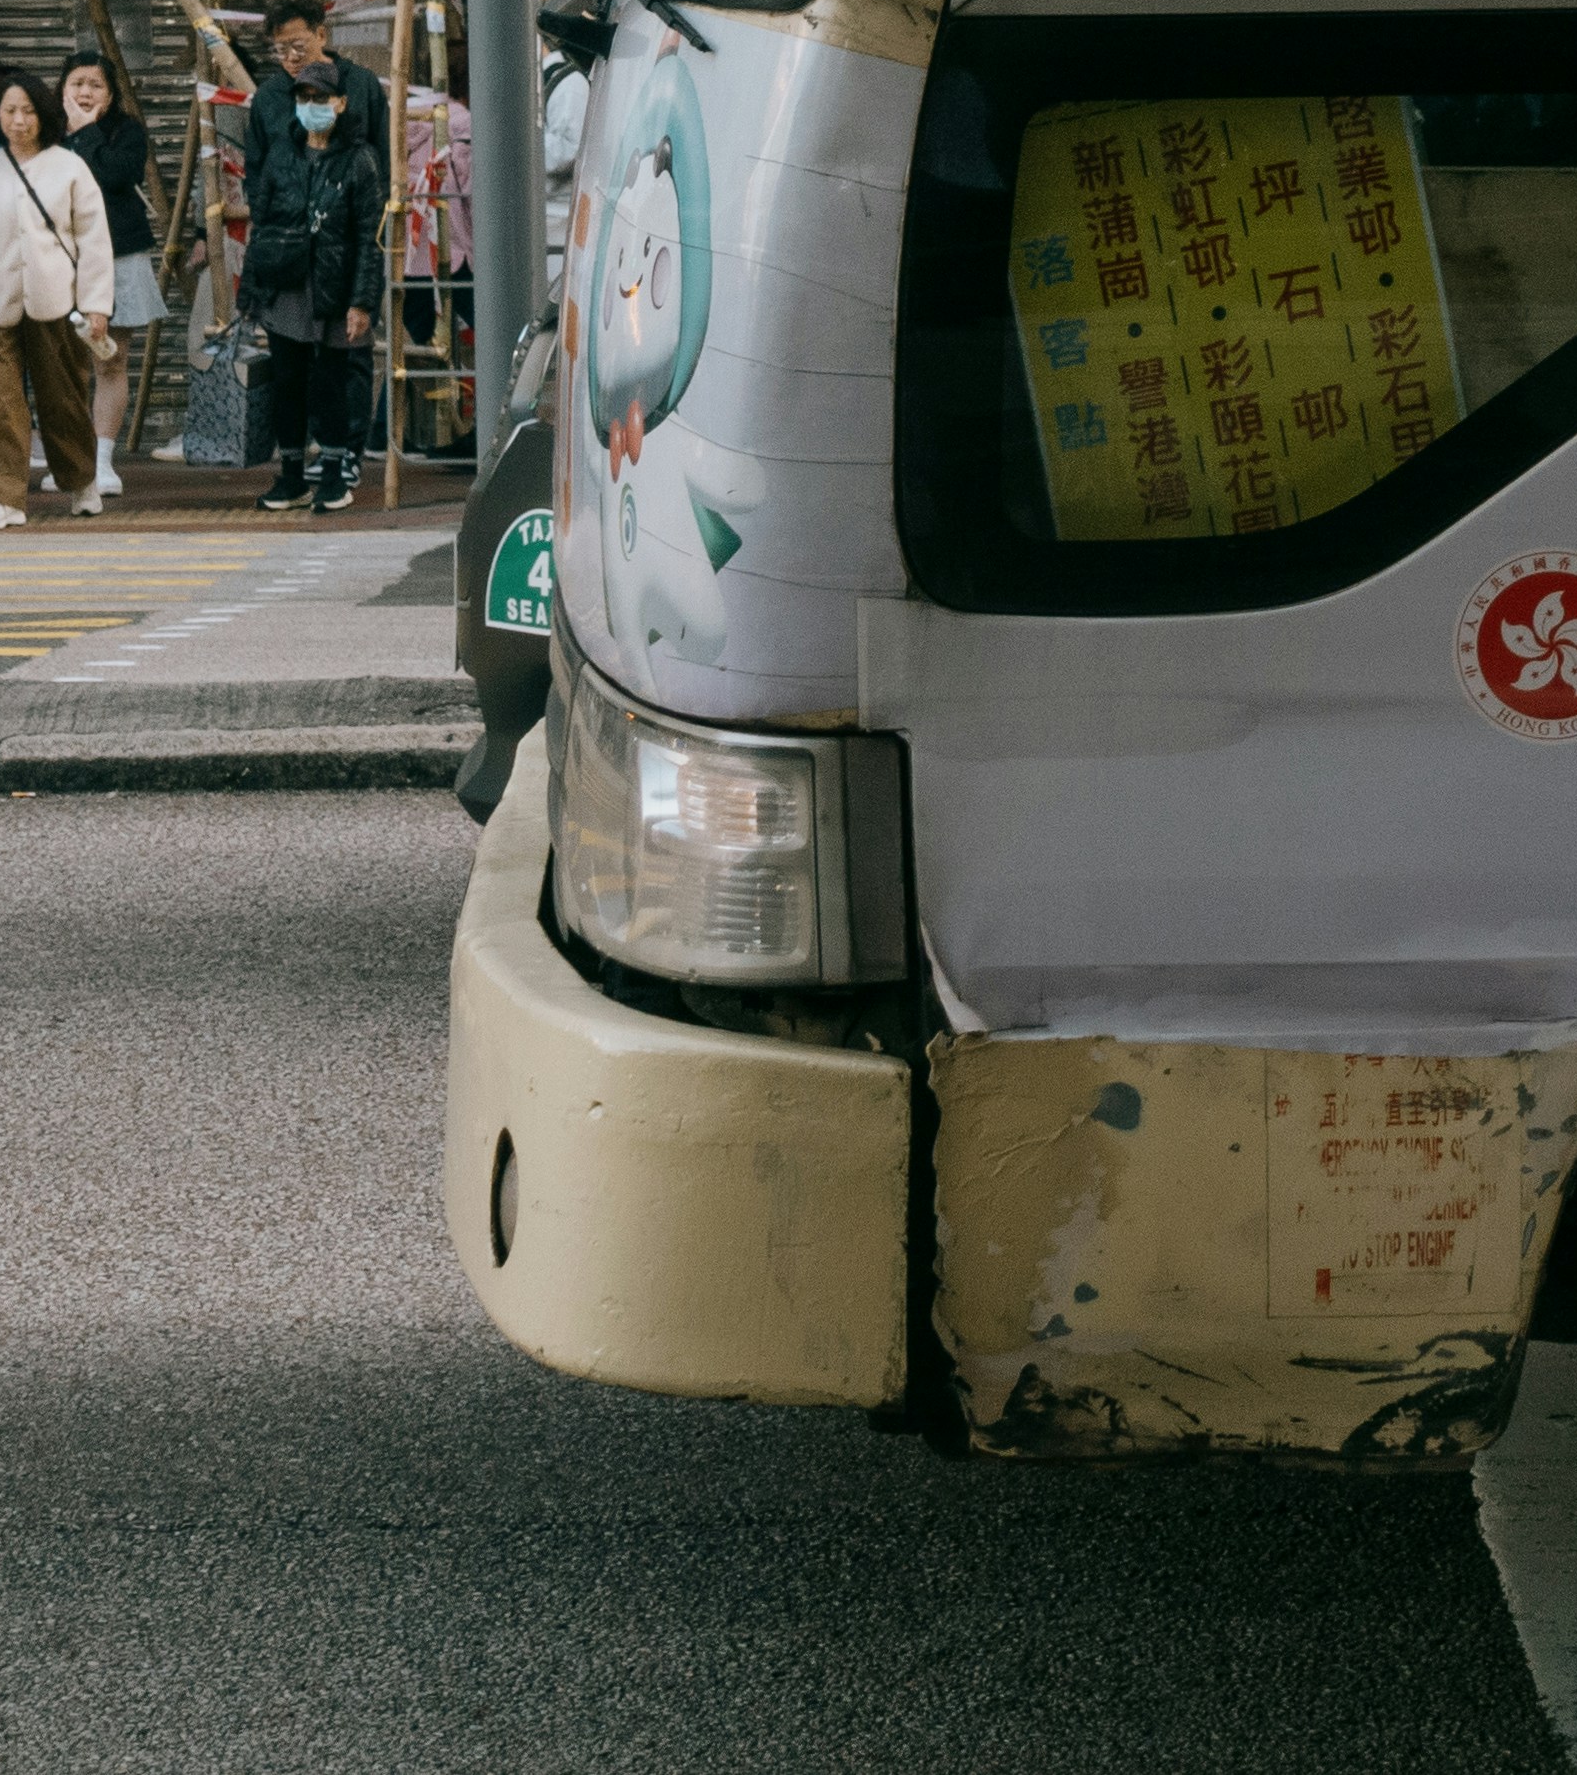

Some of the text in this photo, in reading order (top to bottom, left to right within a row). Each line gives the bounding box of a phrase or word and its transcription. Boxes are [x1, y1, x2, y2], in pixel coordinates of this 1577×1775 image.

[1022, 235, 1107, 452] 落客點
[527, 550, 553, 597] 4
[506, 597, 550, 626] SEA
[1496, 707, 1551, 736] HONG
